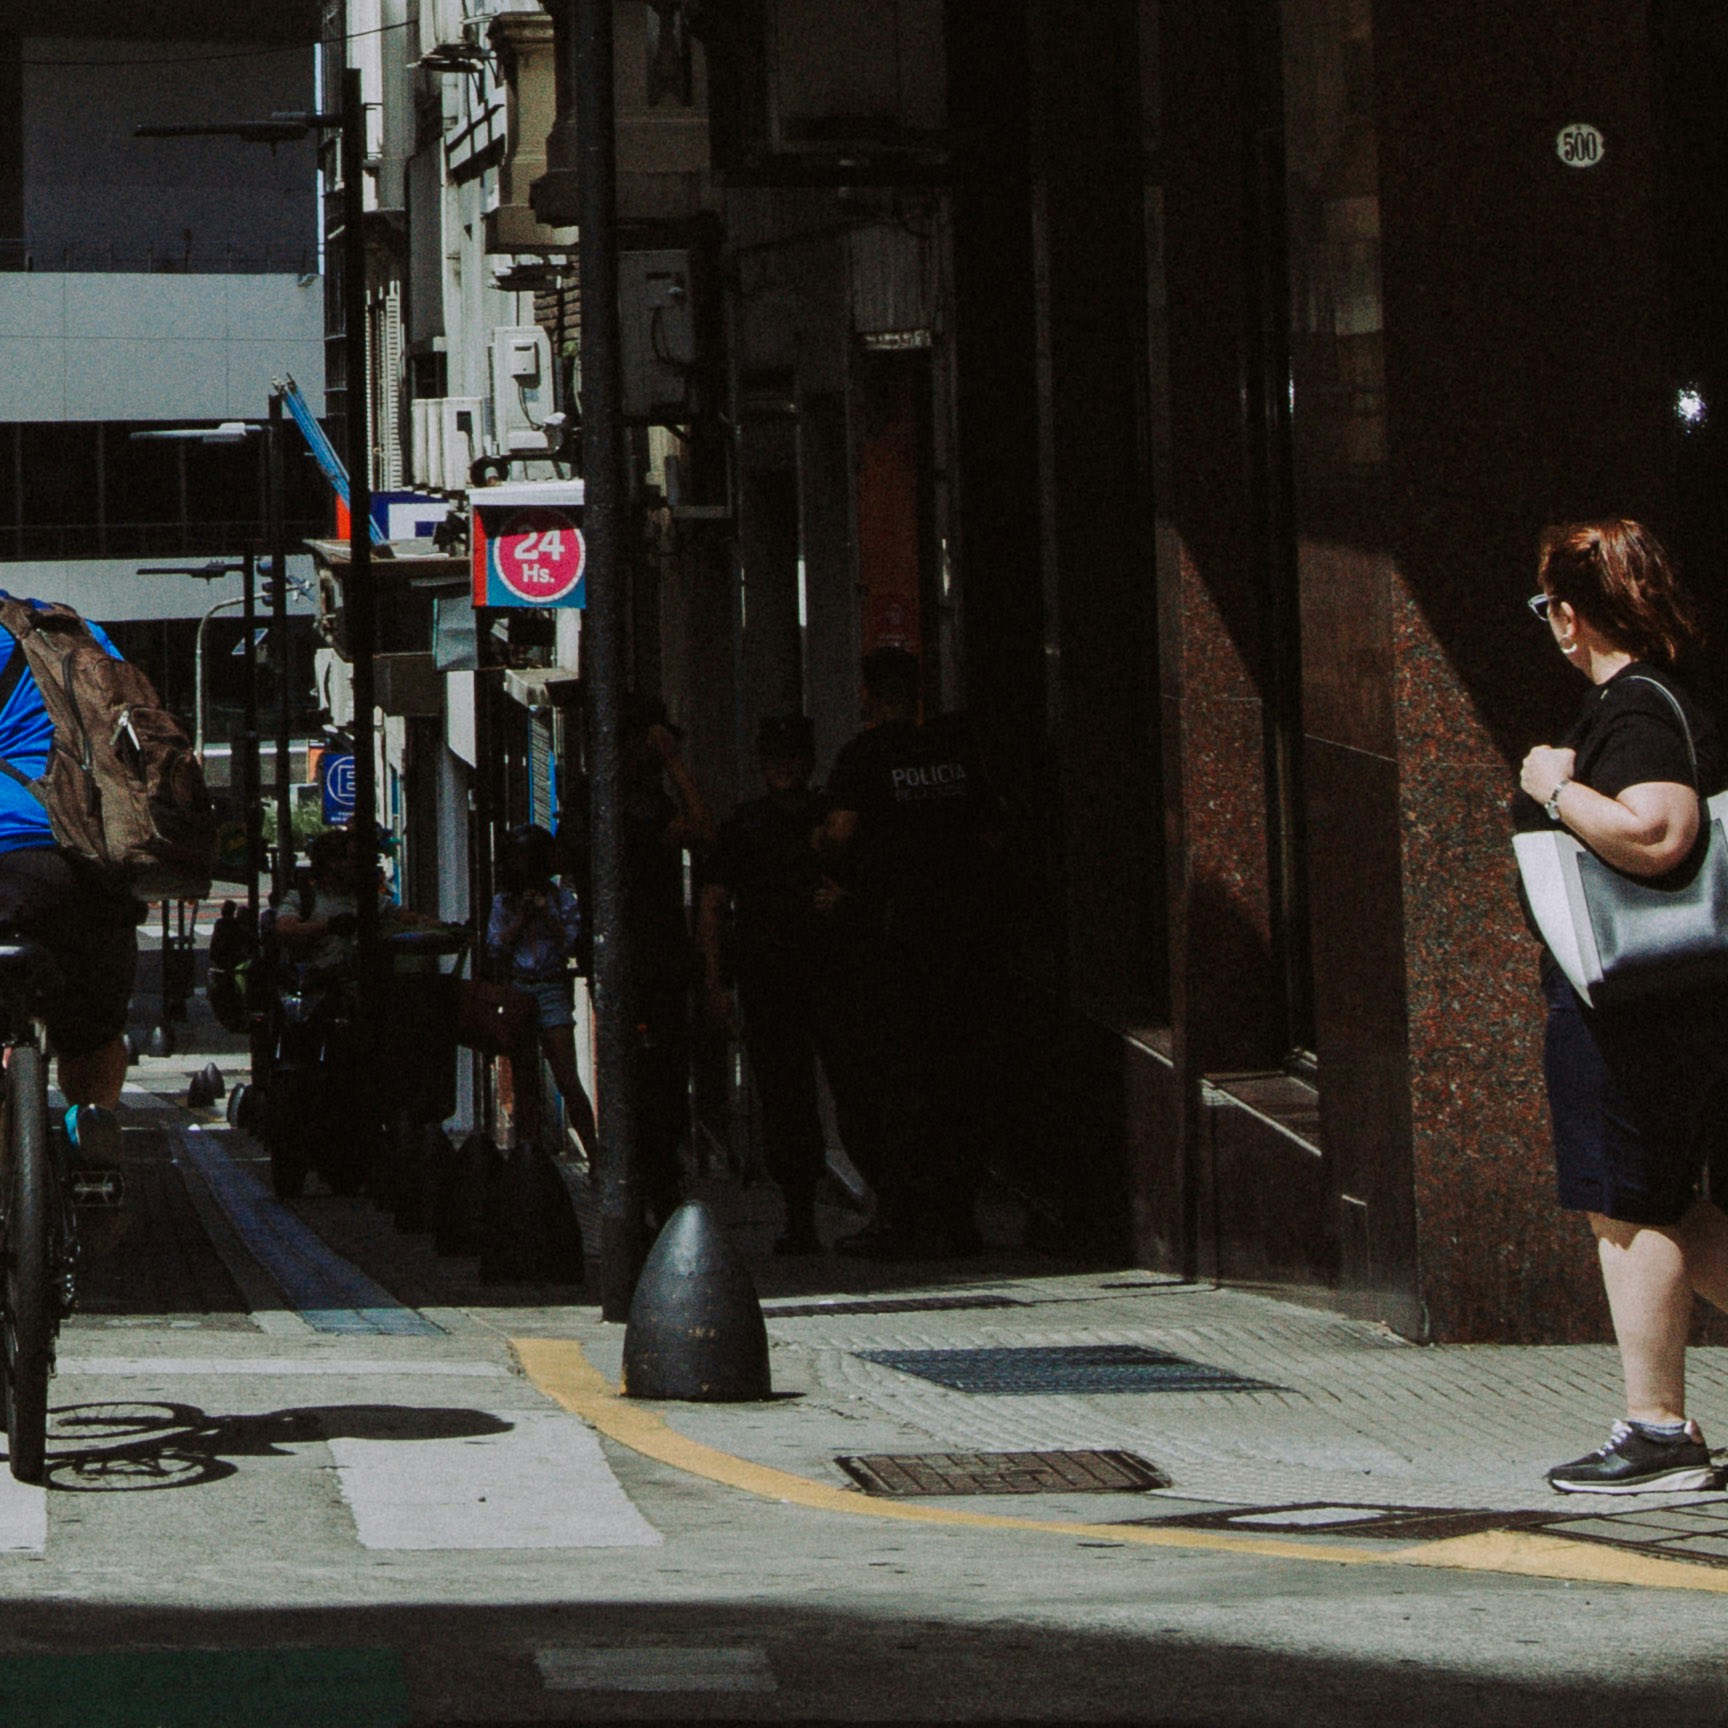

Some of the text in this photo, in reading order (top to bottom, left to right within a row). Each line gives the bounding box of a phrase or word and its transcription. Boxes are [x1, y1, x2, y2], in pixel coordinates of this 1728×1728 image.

[1563, 132, 1597, 161] 500
[514, 524, 566, 561] 24
[521, 563, 556, 583] Hs.
